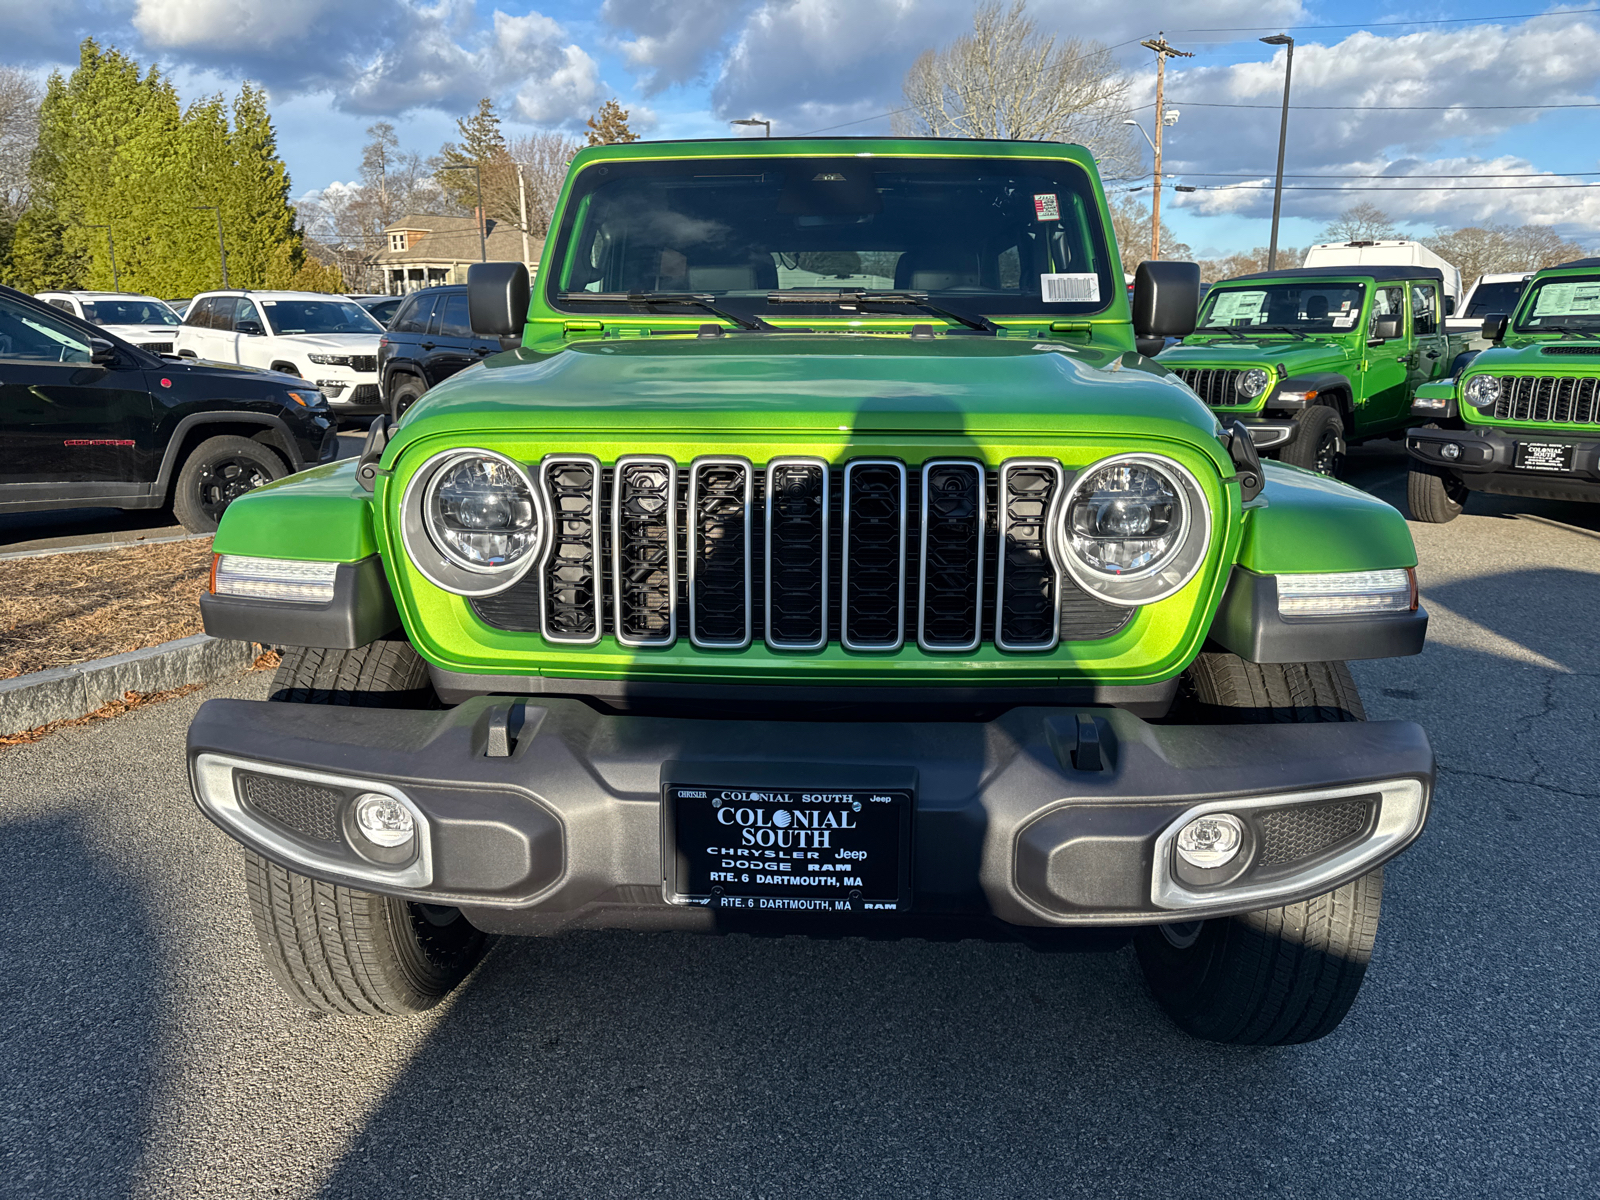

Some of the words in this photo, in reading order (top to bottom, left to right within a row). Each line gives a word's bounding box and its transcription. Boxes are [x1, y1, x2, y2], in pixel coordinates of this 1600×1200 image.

[677, 790, 708, 799] CHRYSLER
[721, 791, 794, 803] COLONIAL
[802, 794, 854, 804] SOUTH
[869, 795, 892, 804] Jeep
[717, 807, 857, 829] COLONIAL
[741, 828, 832, 849] SOUTH
[706, 847, 820, 859] CHRYSLER
[834, 848, 868, 862] Jeep
[721, 859, 792, 871] DODGE
[807, 864, 852, 872] RAM
[710, 872, 738, 882] RTE.
[741, 873, 750, 883] 6
[756, 874, 840, 888] DARTMOUTH,
[843, 877, 863, 887] MA
[721, 897, 745, 908] RTE.
[747, 899, 755, 908] 6
[760, 899, 832, 911] DARTMOUTH,
[835, 901, 852, 911] MA
